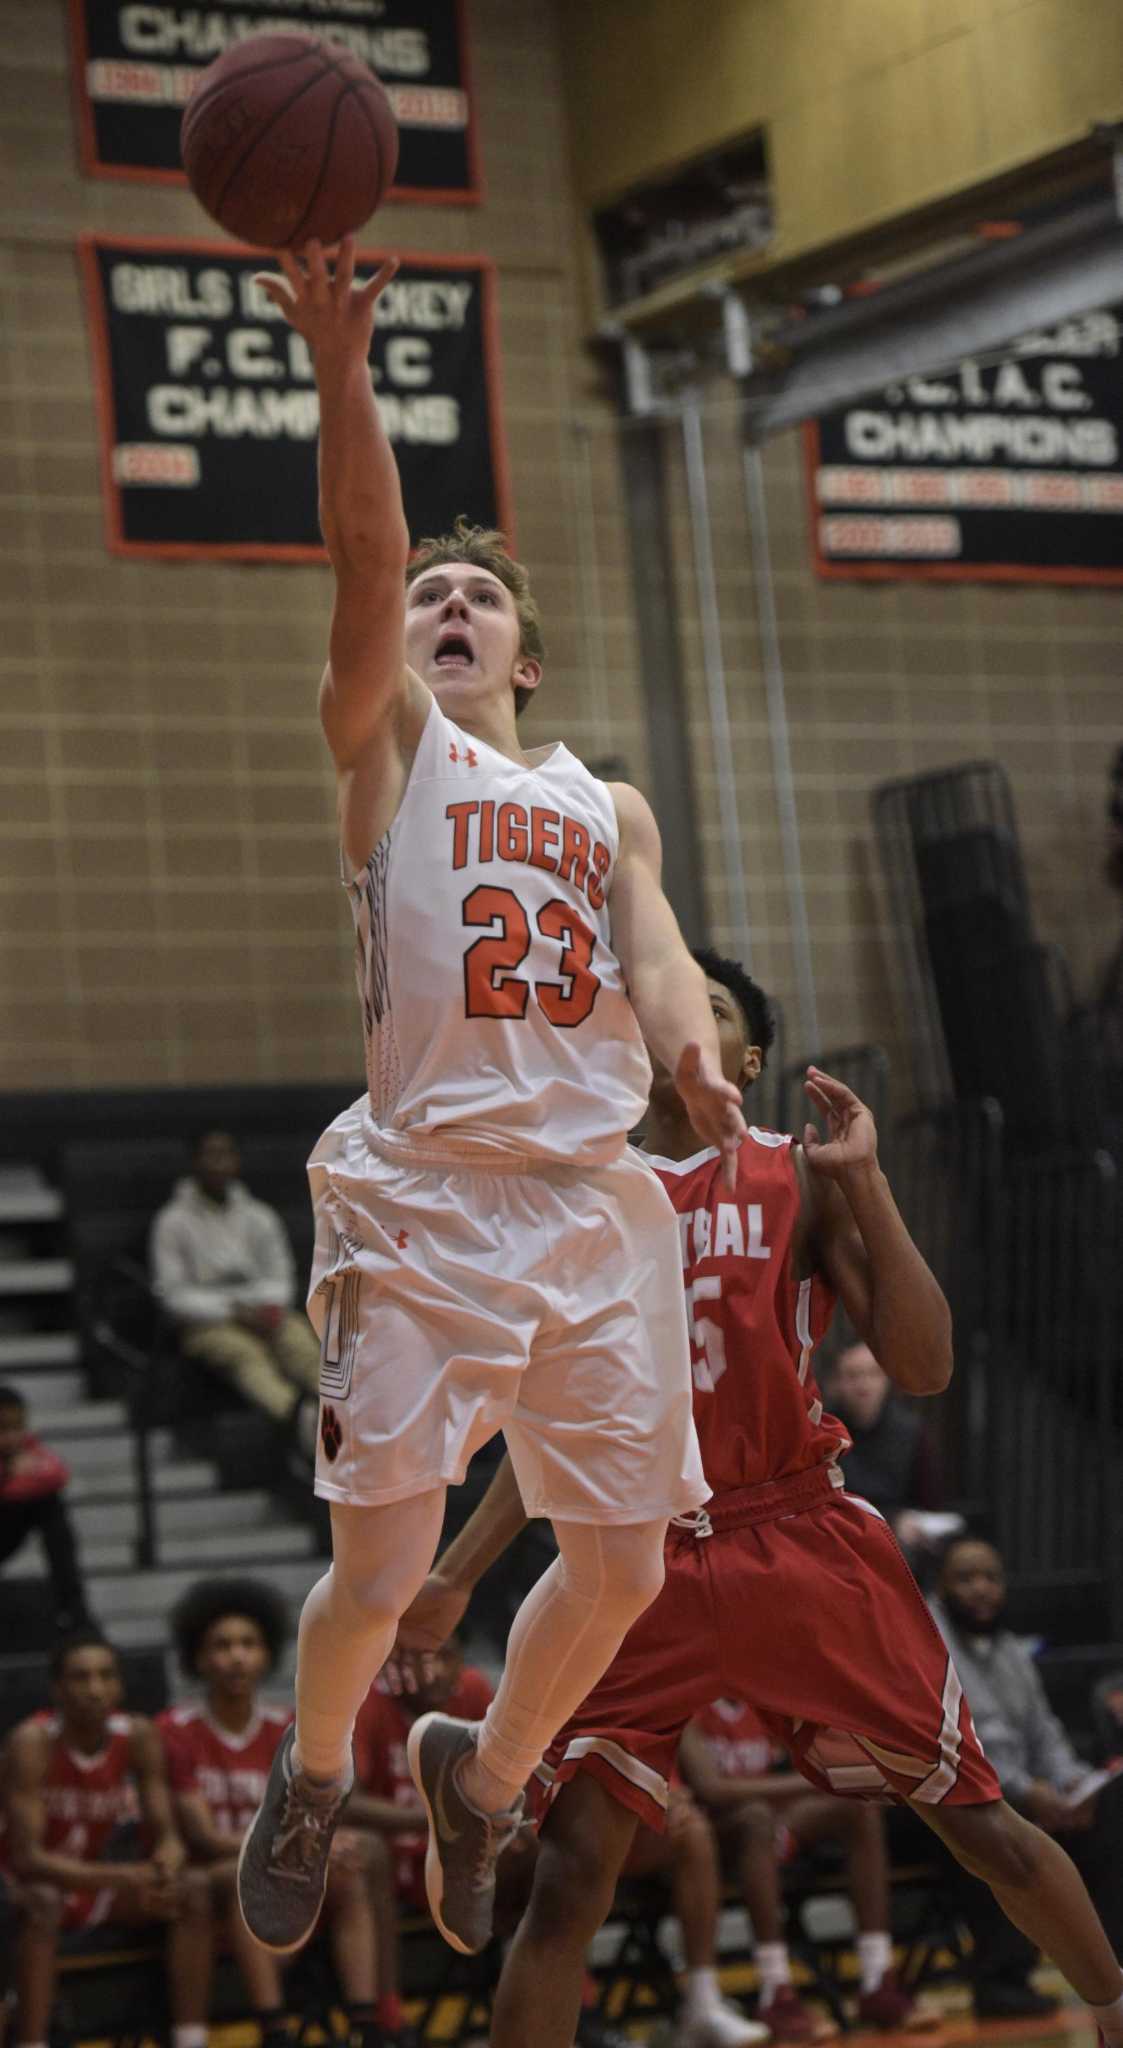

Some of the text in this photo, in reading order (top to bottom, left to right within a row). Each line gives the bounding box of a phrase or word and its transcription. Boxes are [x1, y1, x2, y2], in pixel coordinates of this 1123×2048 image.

[119, 5, 431, 75] CHAONS
[110, 263, 232, 318] GIRLS
[844, 410, 1118, 467] CHAMPIONS
[445, 799, 611, 911] TIGERS
[461, 883, 602, 1029] 23
